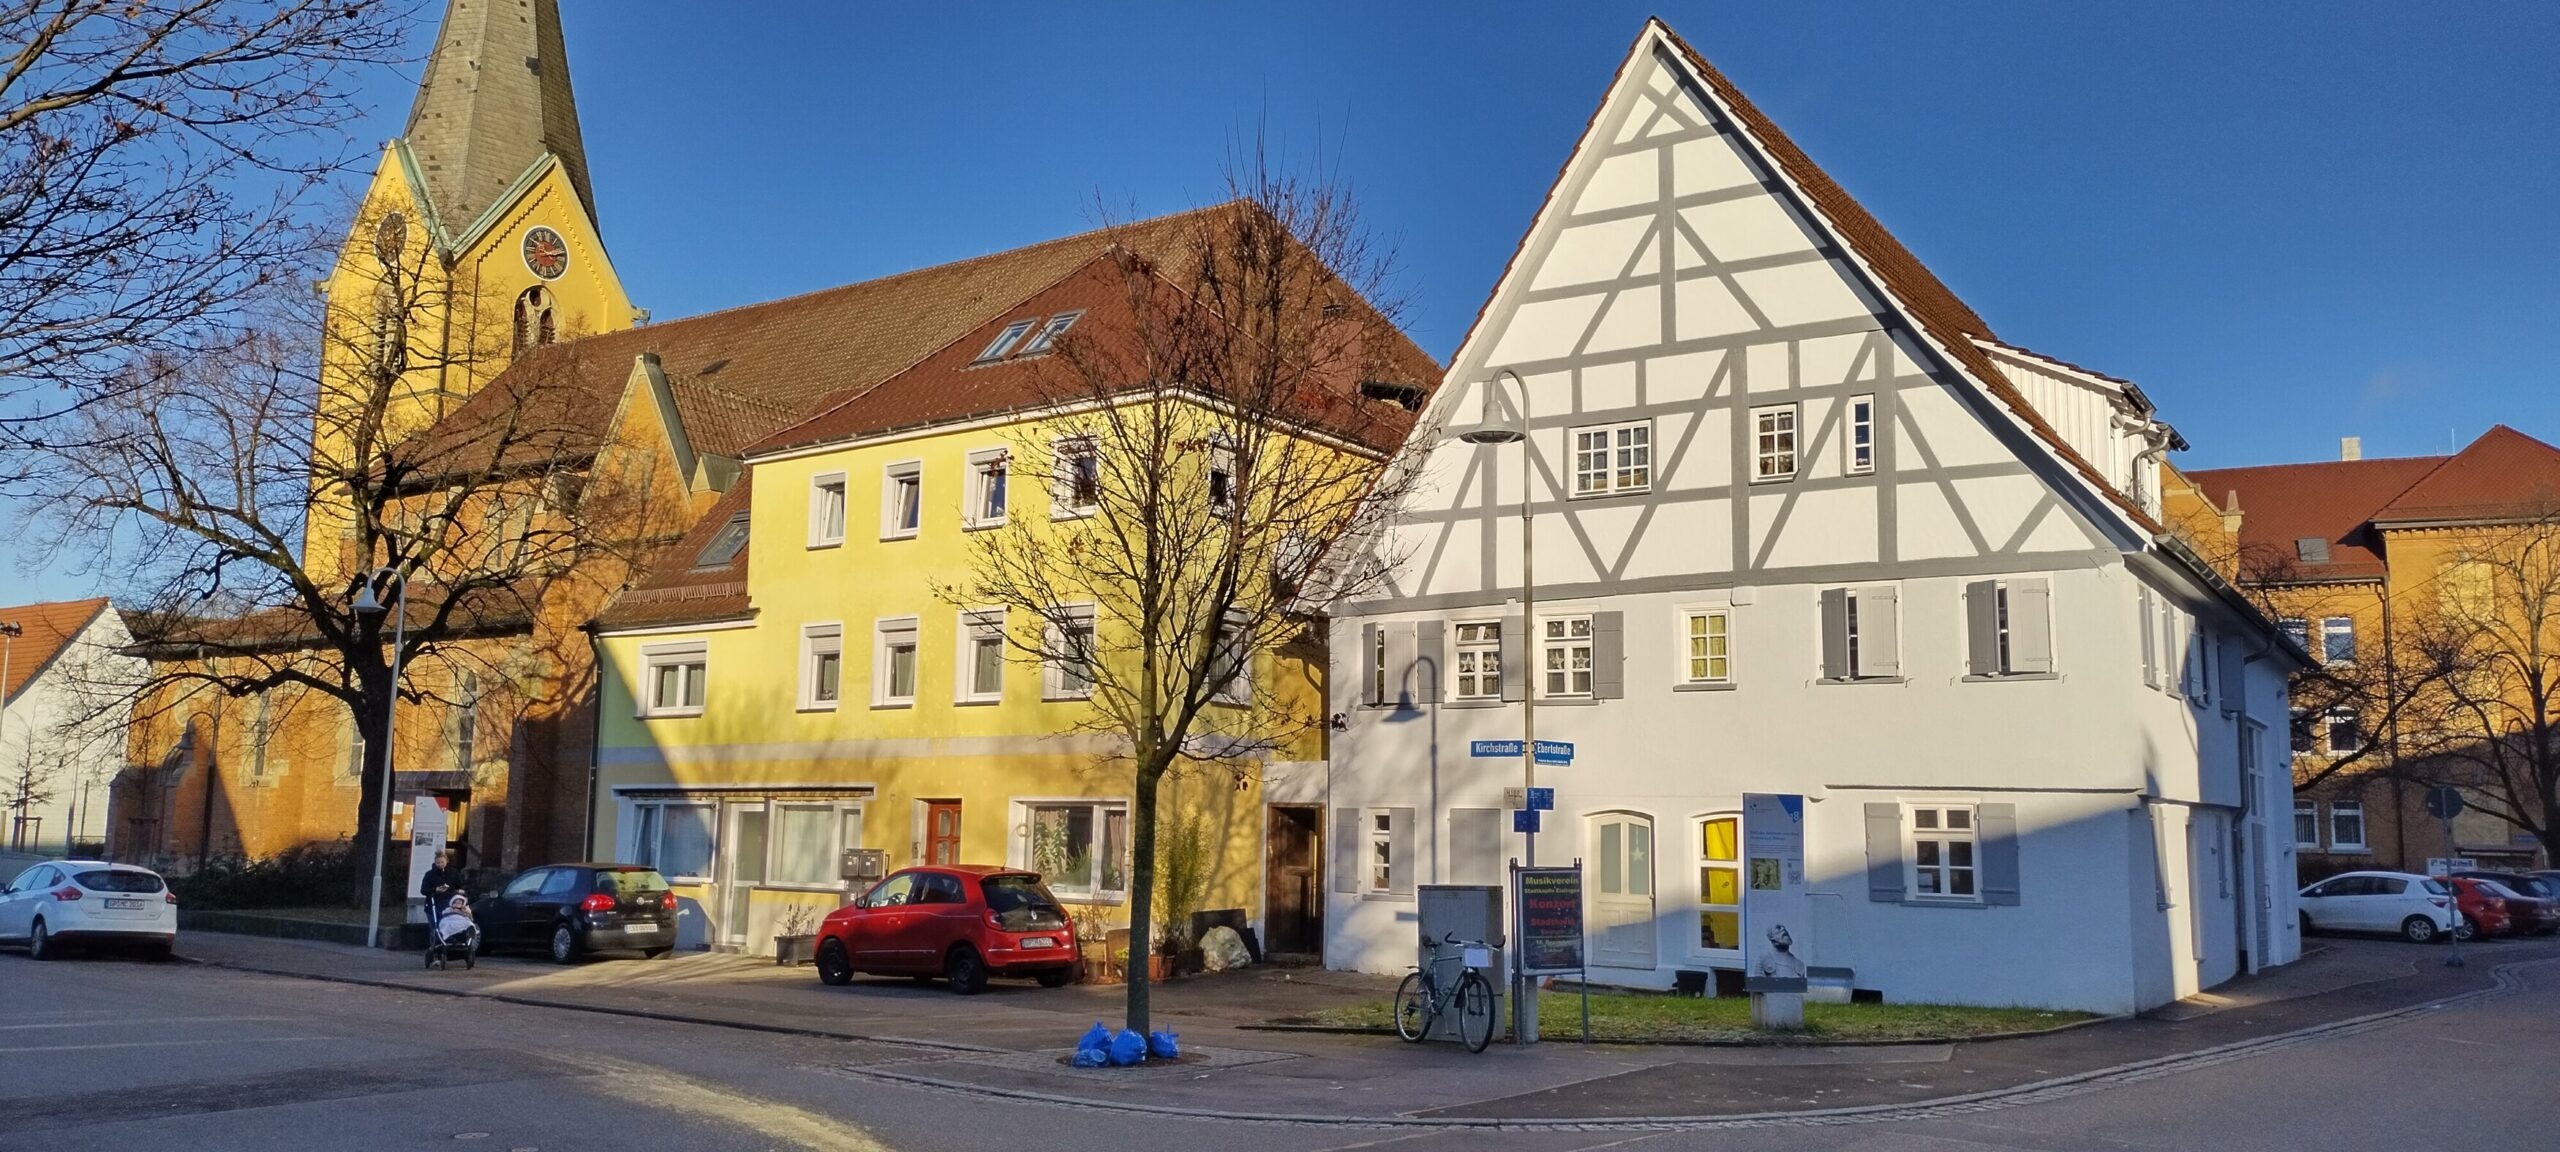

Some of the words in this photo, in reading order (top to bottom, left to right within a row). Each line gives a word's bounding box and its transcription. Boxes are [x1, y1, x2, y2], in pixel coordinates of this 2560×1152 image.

[1475, 742, 1518, 753] Kirchstraße
[1537, 742, 1571, 755] Ebertstraße
[1525, 876, 1579, 885] Musikverein
[1528, 899, 1577, 909] Konzert
